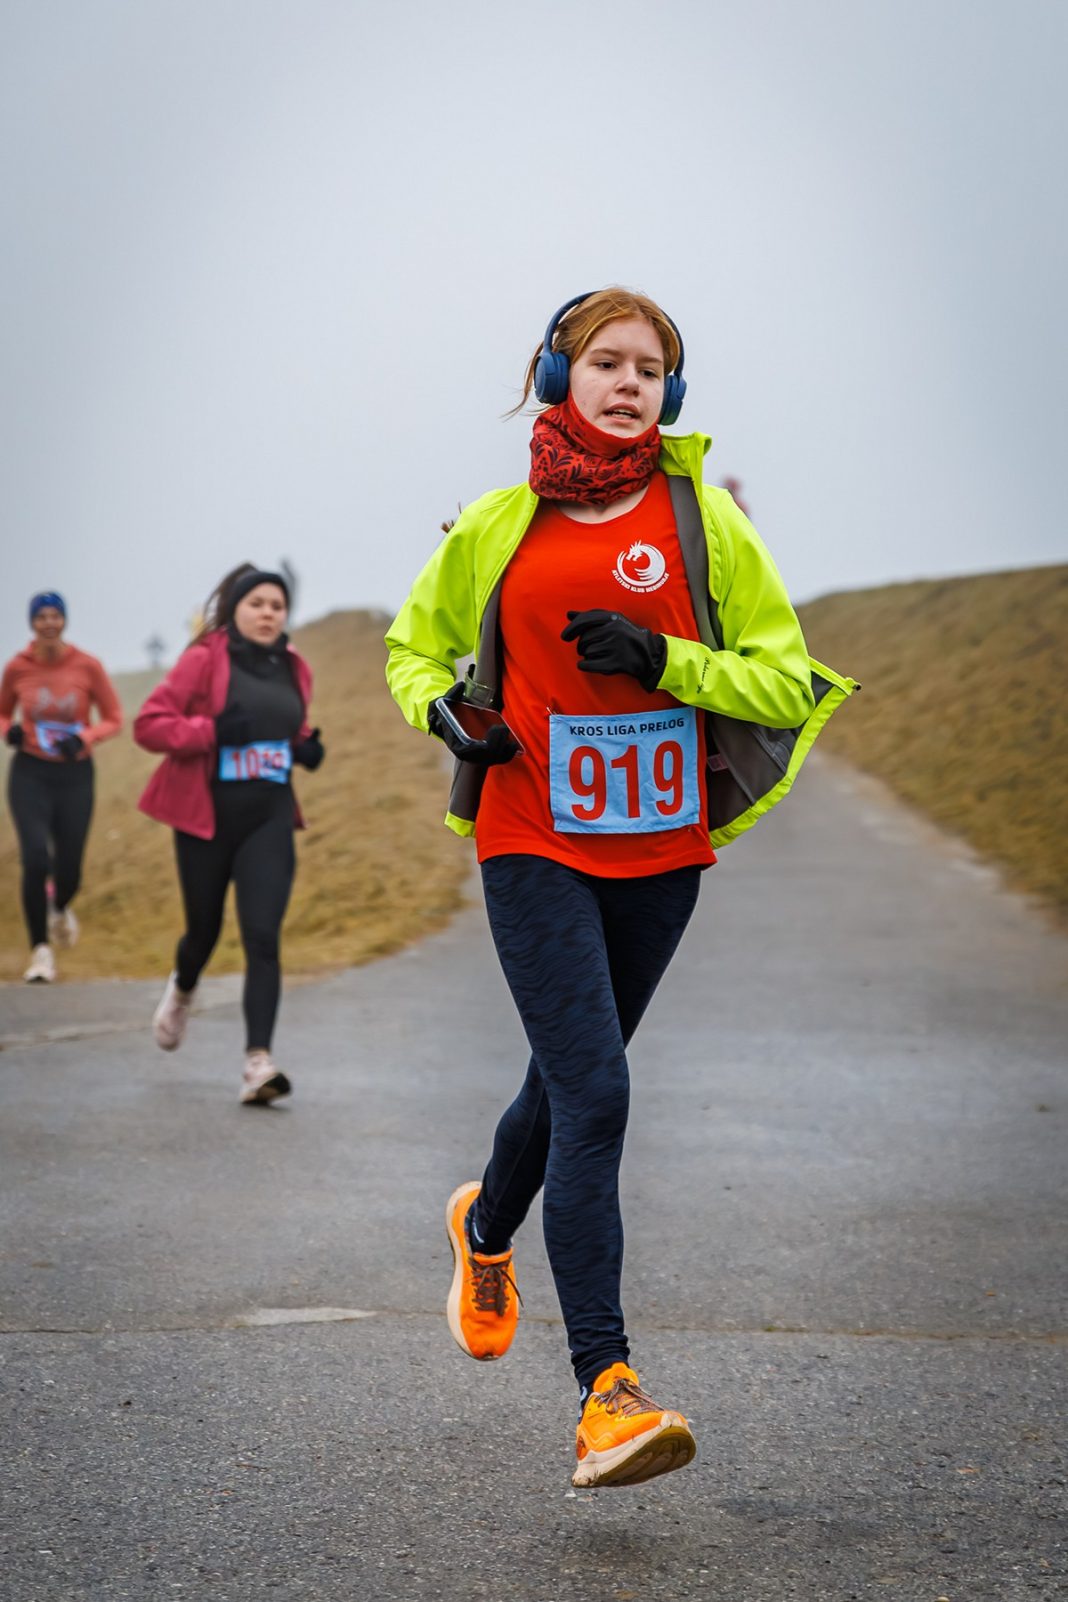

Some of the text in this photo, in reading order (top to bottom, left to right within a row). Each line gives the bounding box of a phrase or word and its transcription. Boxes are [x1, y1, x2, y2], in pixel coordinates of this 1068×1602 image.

[569, 717, 685, 736] KROS LIGA PRELOG
[568, 740, 684, 821] 919
